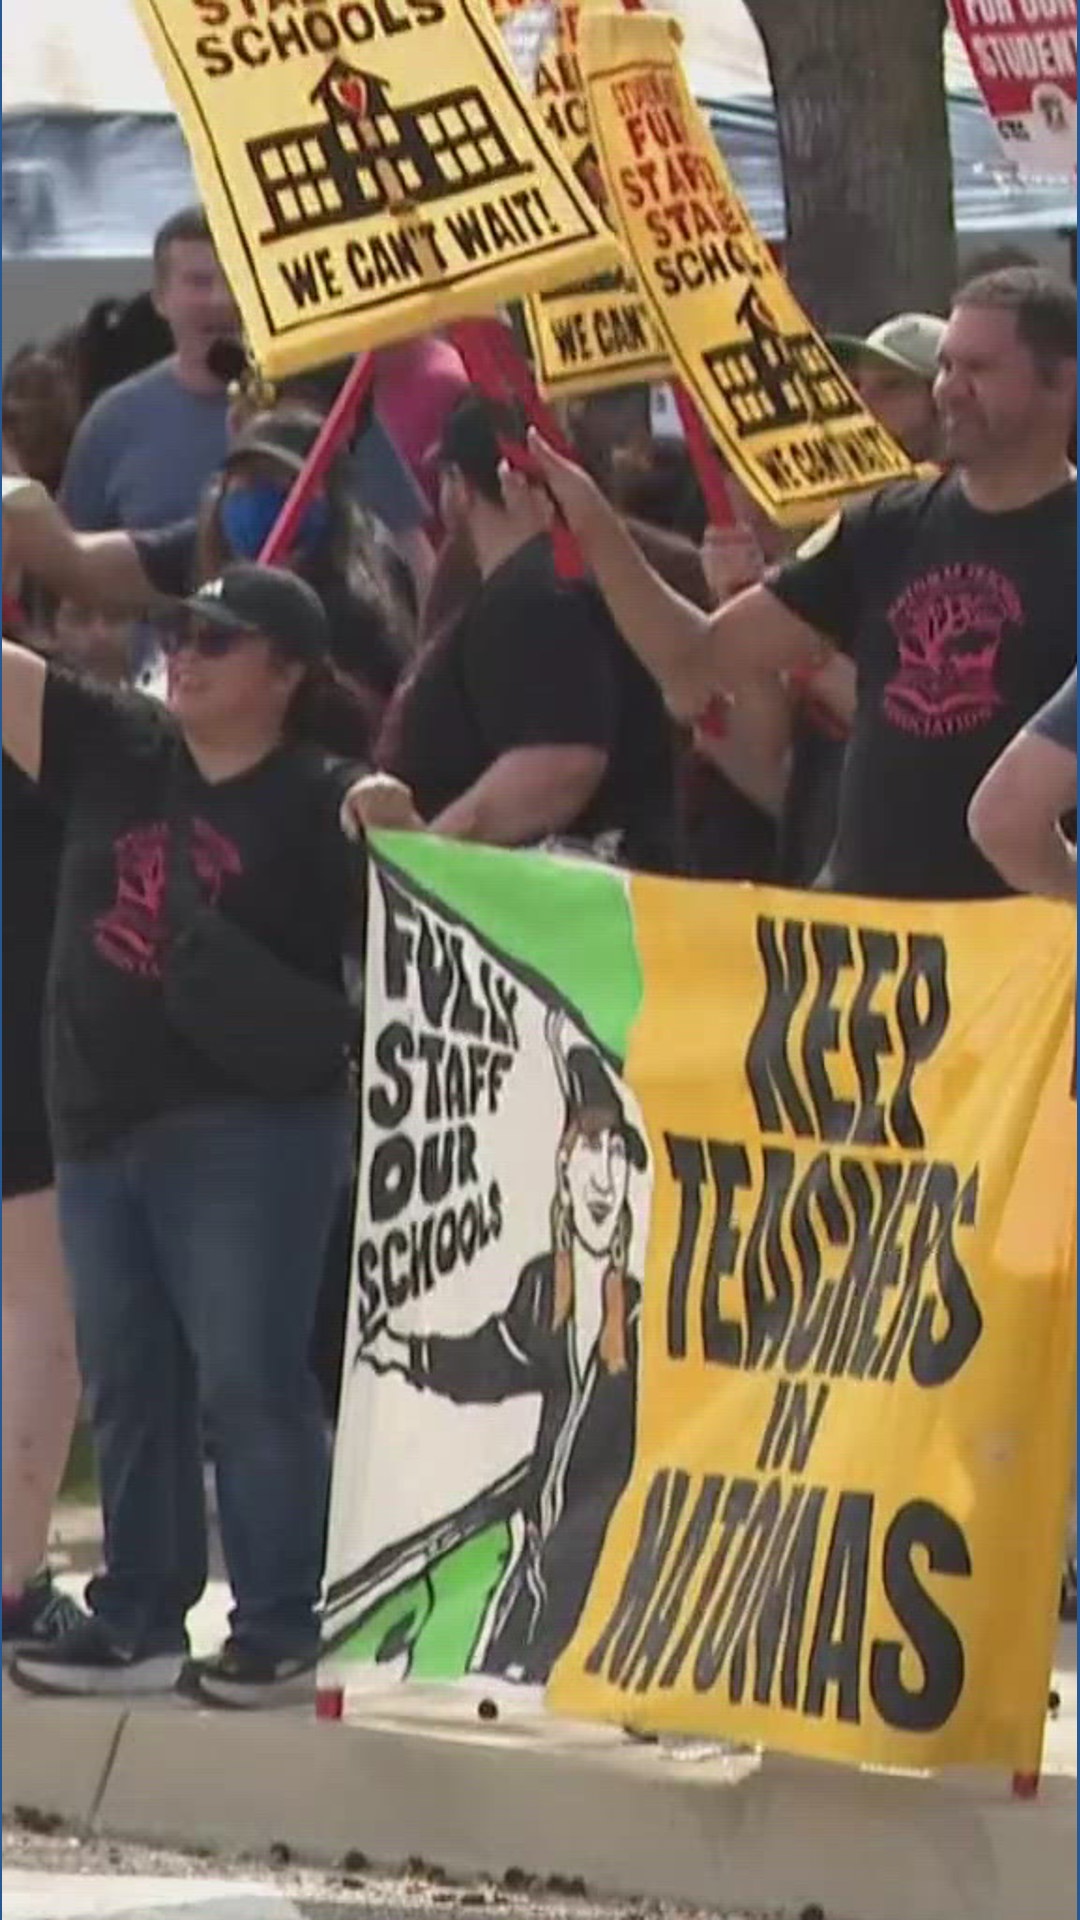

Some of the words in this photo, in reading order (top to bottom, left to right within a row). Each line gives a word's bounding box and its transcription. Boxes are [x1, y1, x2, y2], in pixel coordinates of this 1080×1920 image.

[195, 0, 446, 77] SCHOOLS
[971, 28, 1077, 79] STUDEN
[278, 247, 343, 308] WE
[345, 222, 449, 290] CAN'T
[444, 188, 561, 262] WAIT!
[551, 312, 593, 367] WE
[380, 874, 520, 1051] FULLY
[368, 1019, 514, 1130] STAFF
[744, 913, 951, 1150] KEEP
[369, 1122, 480, 1224] OUR
[357, 1180, 503, 1324] SCHOOLS
[662, 1129, 984, 1389] TEACHERS
[755, 1377, 830, 1472] IN
[583, 1466, 973, 1733] NATOMAS
